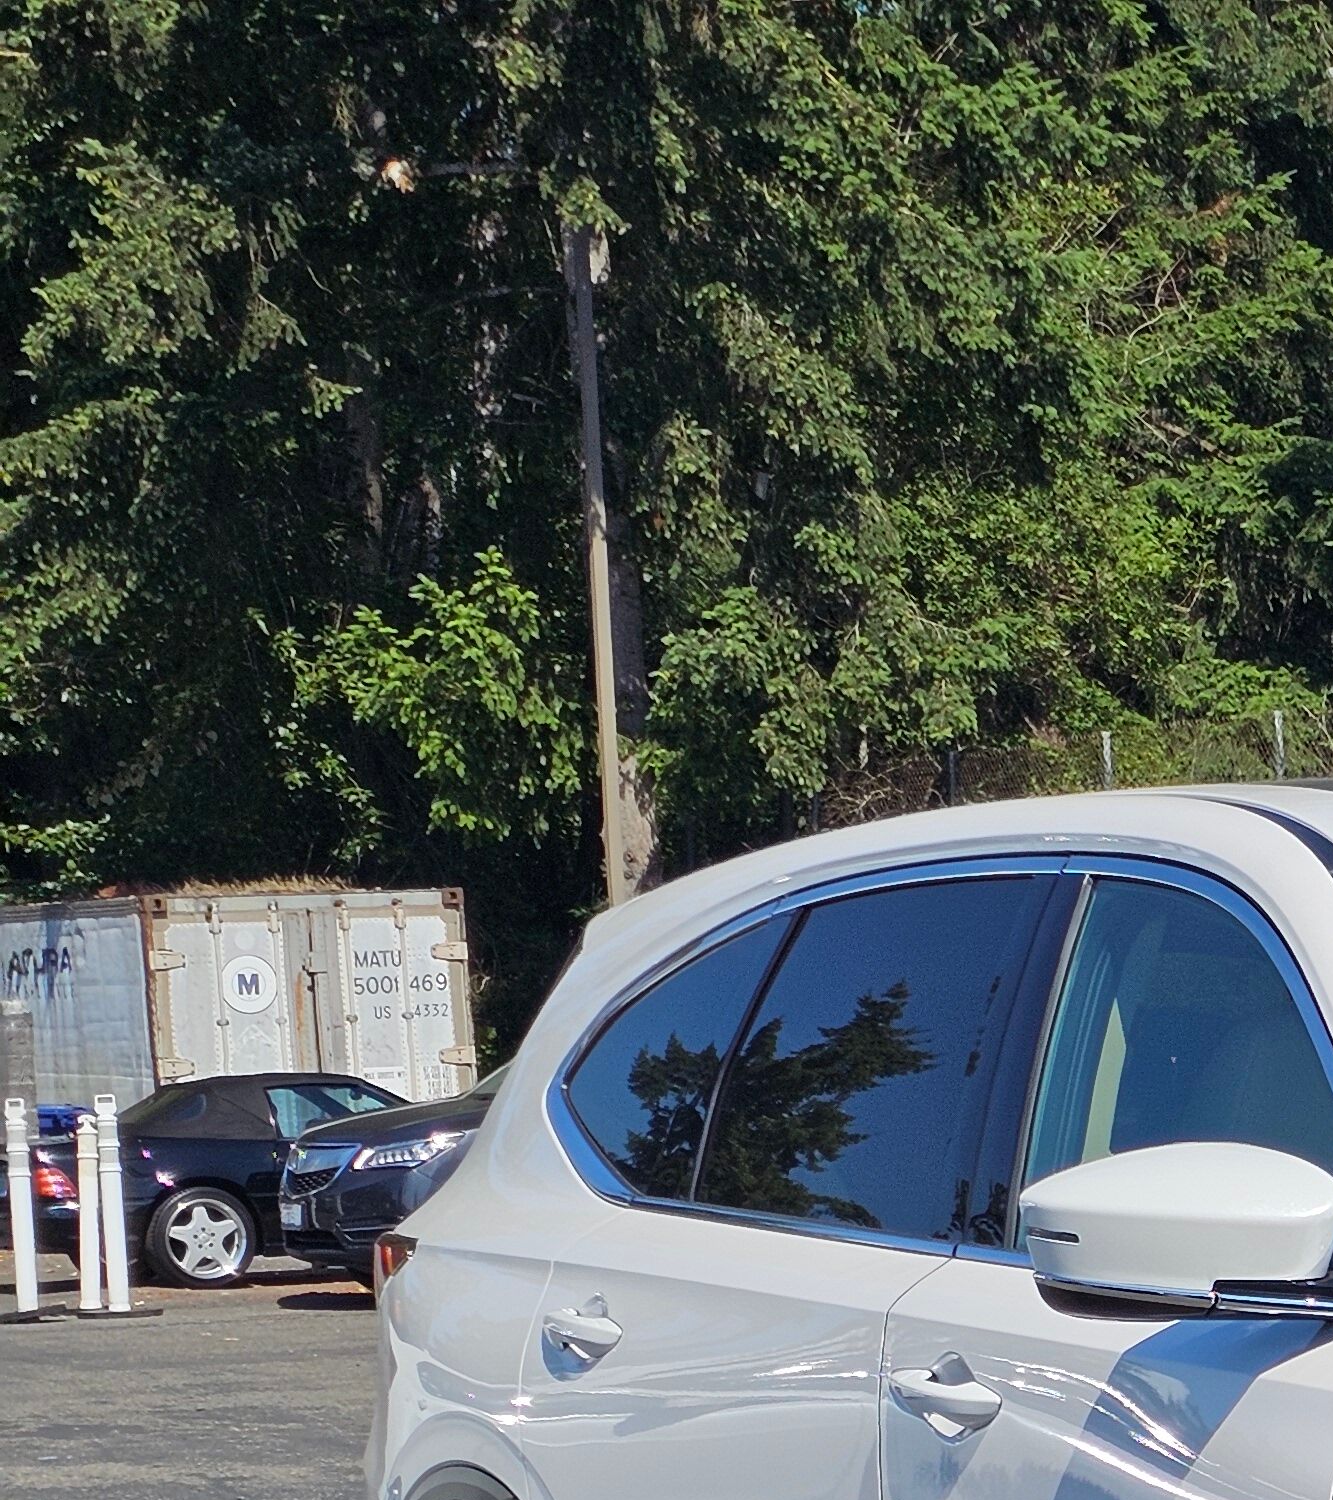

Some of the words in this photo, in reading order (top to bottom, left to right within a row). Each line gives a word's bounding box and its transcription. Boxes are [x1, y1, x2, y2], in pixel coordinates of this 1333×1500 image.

[353, 950, 402, 968] MATU
[237, 973, 260, 996] M
[374, 1005, 392, 1020] US
[414, 1003, 449, 1018] 4332
